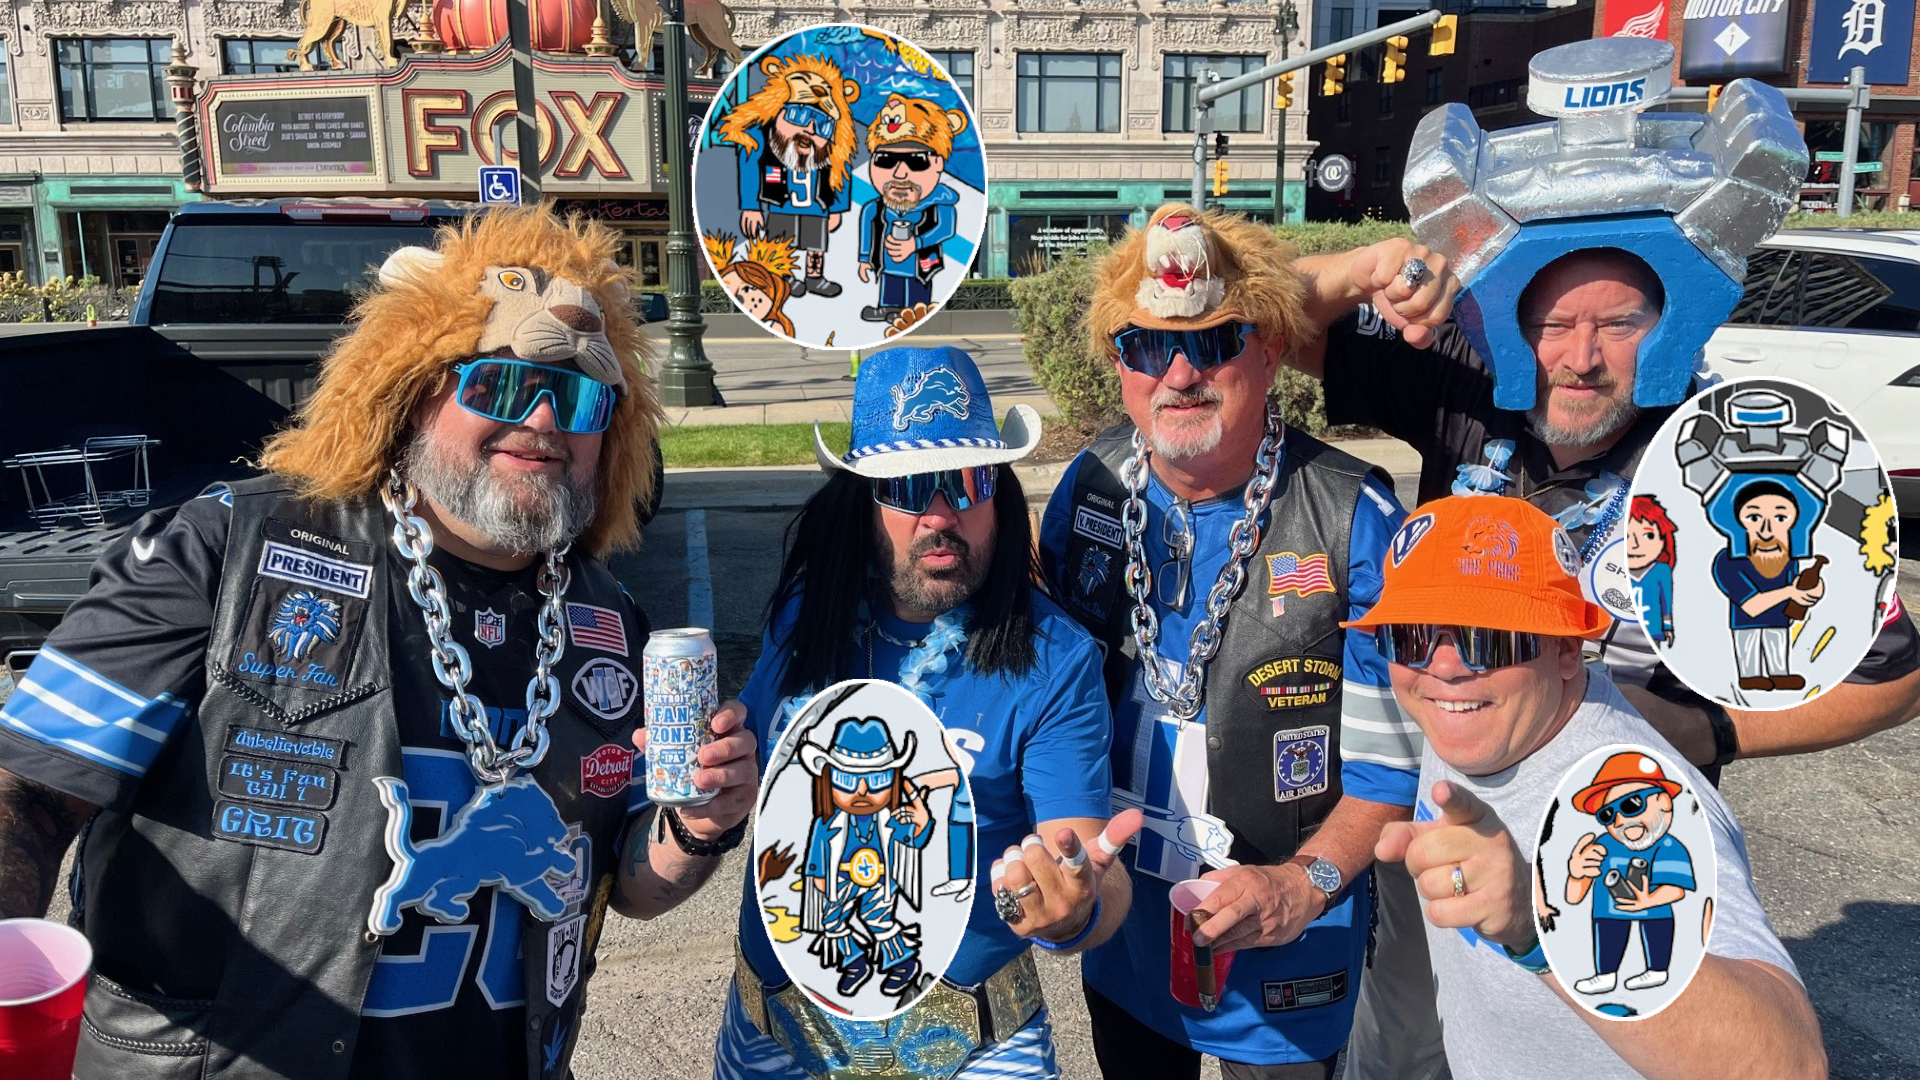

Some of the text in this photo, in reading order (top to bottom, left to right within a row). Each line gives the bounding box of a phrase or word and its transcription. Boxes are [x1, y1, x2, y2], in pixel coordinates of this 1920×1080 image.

[1563, 77, 1647, 108] LIONS
[223, 112, 275, 134] Columbia
[321, 112, 345, 120] EVERYBODY
[229, 131, 271, 152] Street
[402, 88, 629, 178] FOX
[564, 200, 669, 220] Entertai
[1086, 492, 1115, 510] ORIGINAL
[1085, 517, 1122, 541] PRESIDENT
[290, 528, 350, 556] ORIGINAL
[270, 552, 363, 589] PRESIDENT
[480, 625, 501, 641] NFL
[239, 652, 338, 688] Super Fan
[1248, 658, 1343, 688] DESERT STORM
[581, 671, 630, 709] WCF
[653, 694, 691, 703] DETROIT
[1267, 692, 1327, 708] VETERAN
[653, 706, 689, 723] FAN
[235, 730, 335, 760] Unbelievable
[652, 727, 694, 743] ZONE
[1277, 728, 1326, 742] UNITED STATES
[595, 748, 621, 760] MOTOR
[665, 754, 680, 763] IPA
[229, 762, 273, 781] It's
[585, 756, 630, 778] Detroit
[600, 776, 618, 785] CITY
[1279, 782, 1323, 800] AIR FORCE
[221, 806, 316, 845] GRIT
